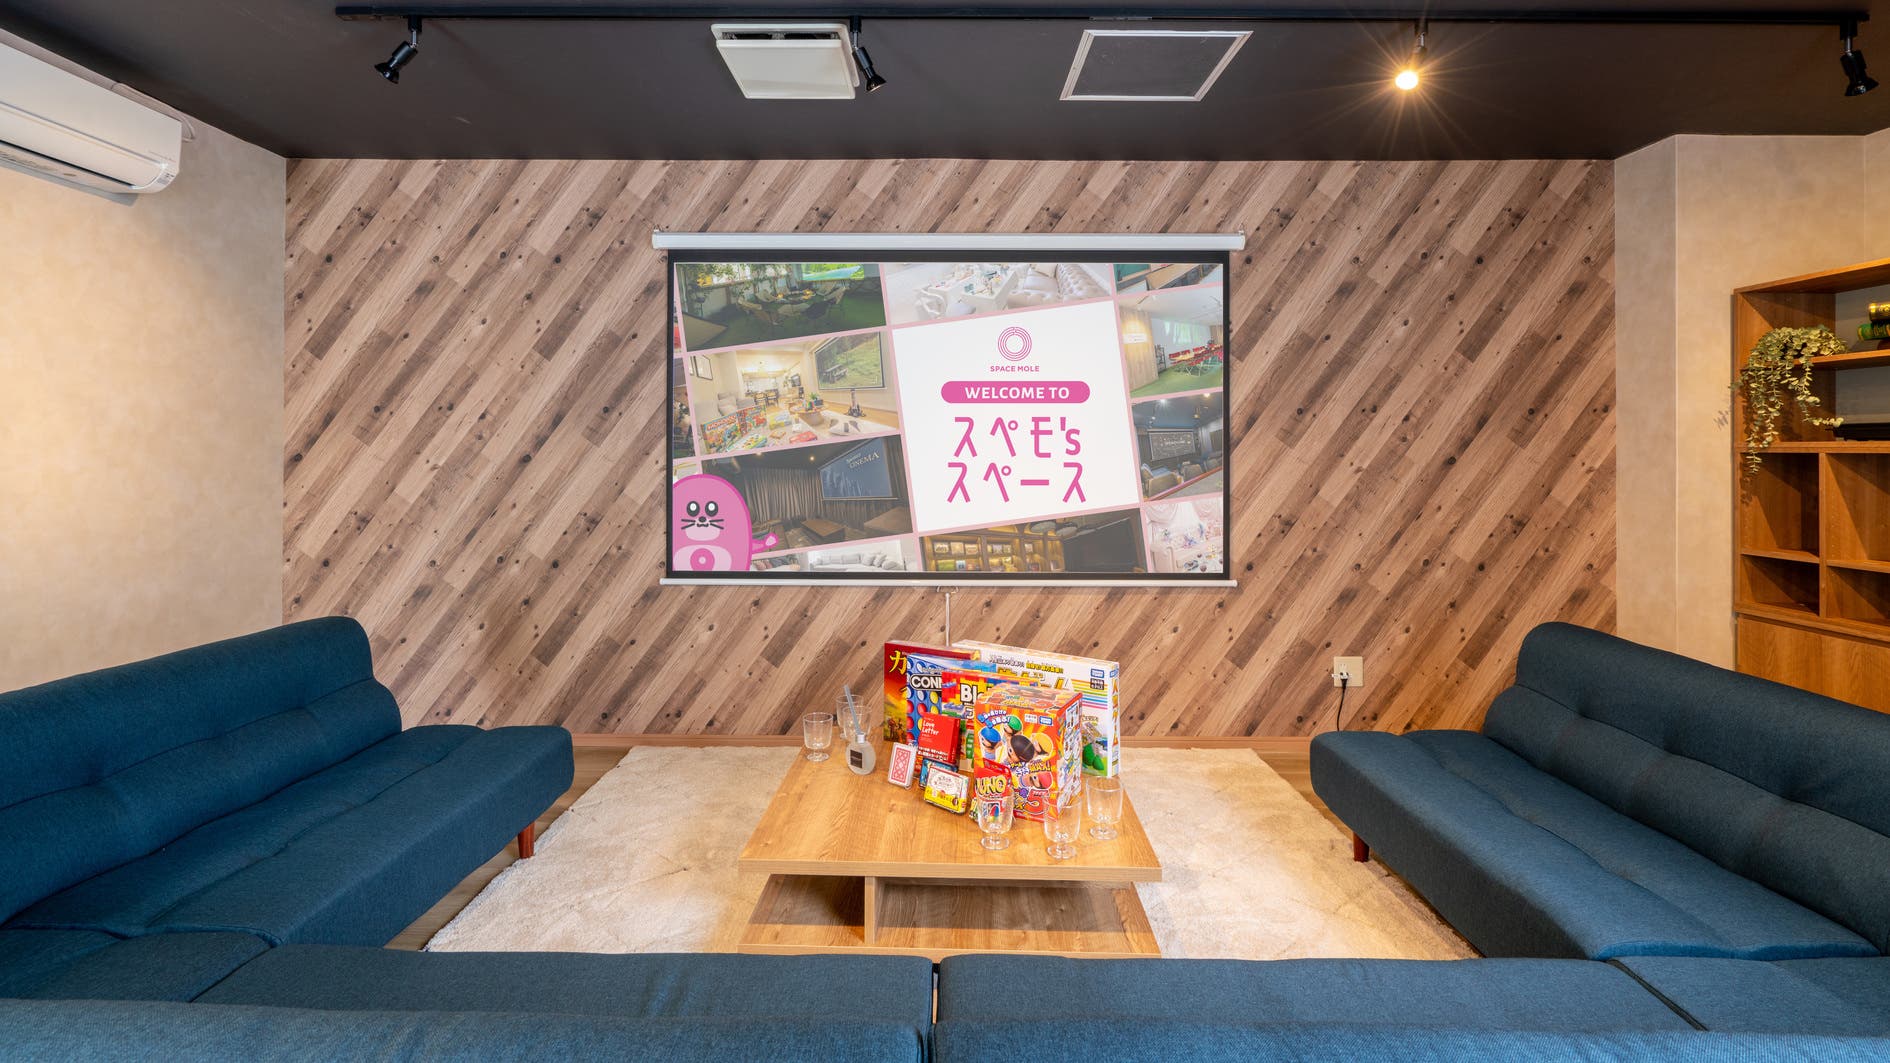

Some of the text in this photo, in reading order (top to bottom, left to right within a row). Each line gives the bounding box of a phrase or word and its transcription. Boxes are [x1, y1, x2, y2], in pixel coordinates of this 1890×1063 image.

[965, 386, 1070, 399] WELCOME TO
[953, 416, 1081, 458] スペモ's
[947, 462, 1087, 503] スペース
[921, 726, 940, 736] Letter
[922, 719, 936, 728] Love
[975, 775, 1007, 796] UNO
